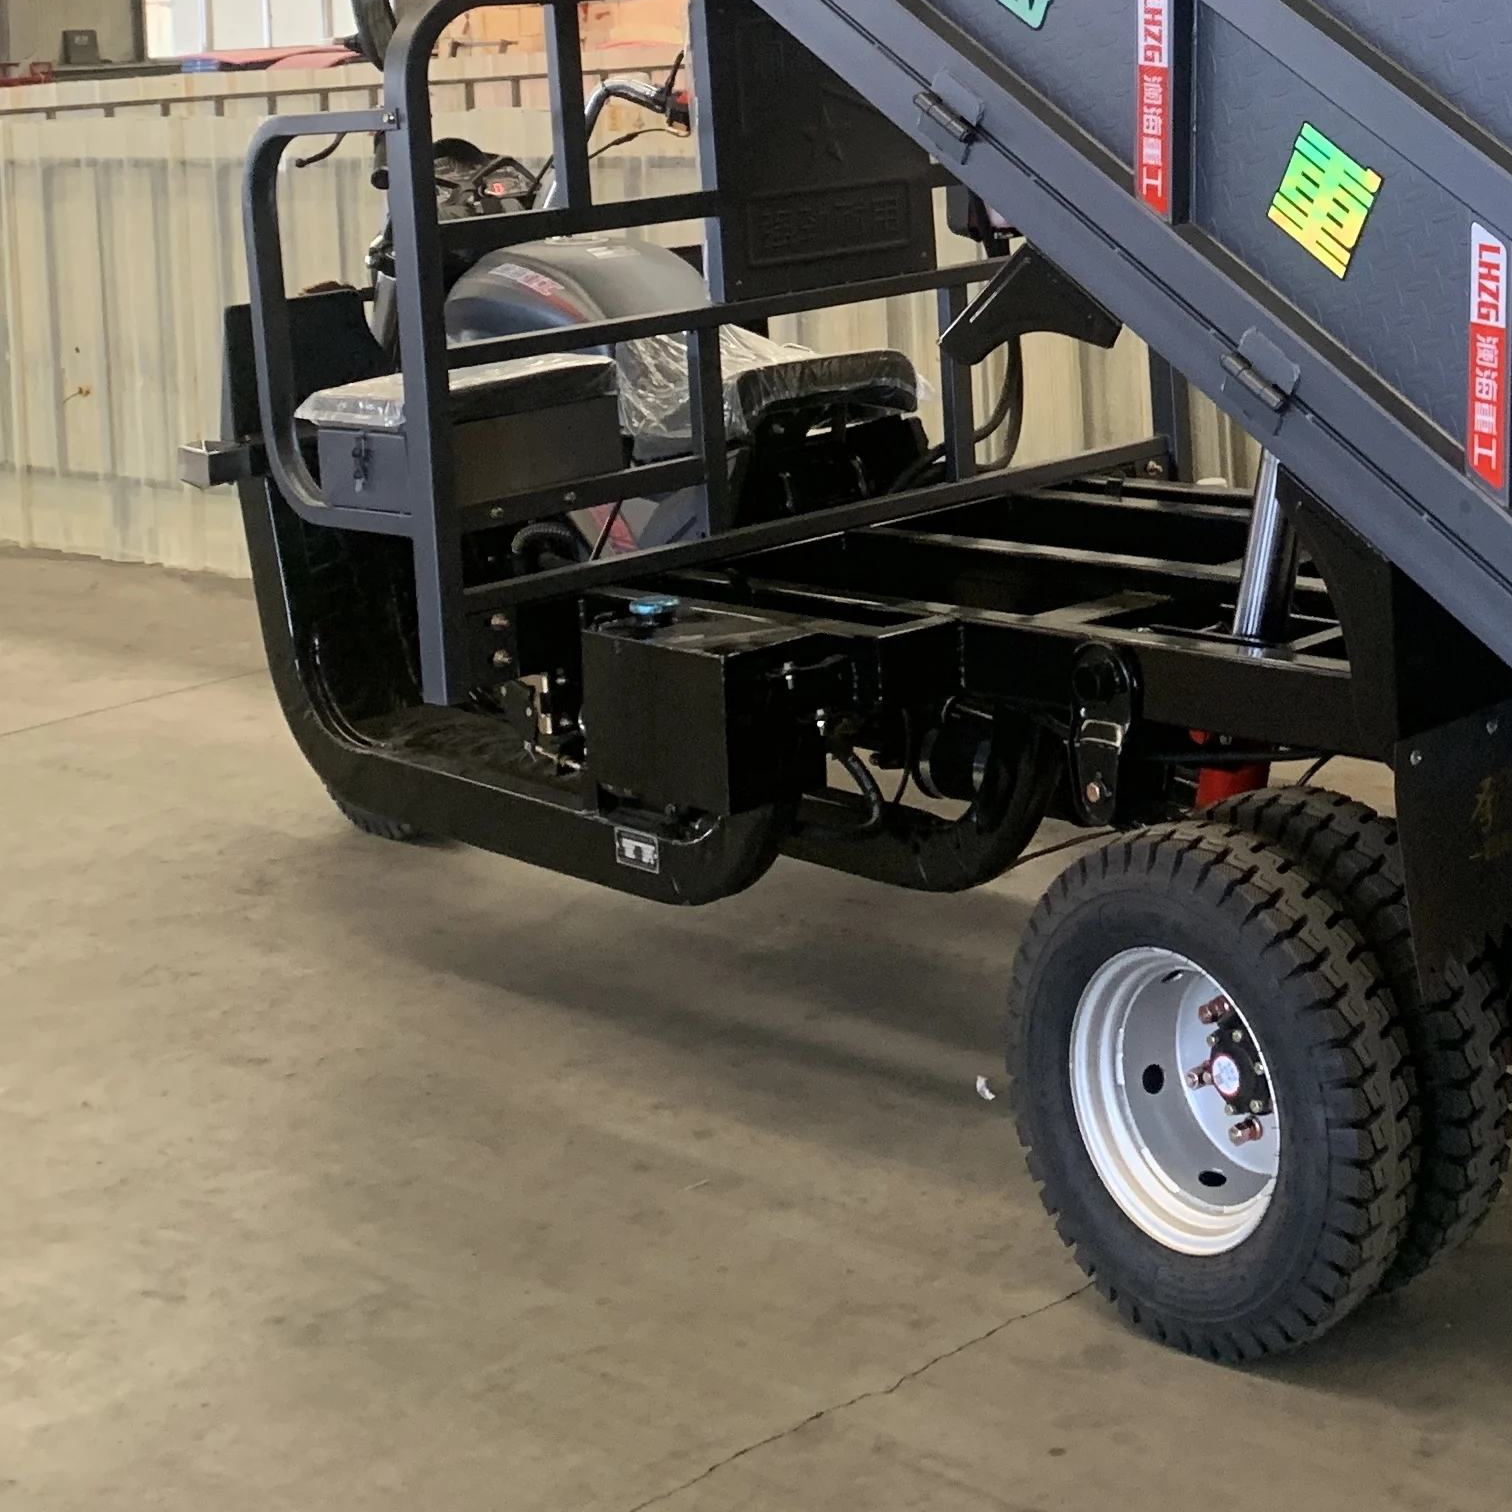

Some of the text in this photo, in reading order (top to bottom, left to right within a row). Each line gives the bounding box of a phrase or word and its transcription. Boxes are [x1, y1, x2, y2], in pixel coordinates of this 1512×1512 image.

[1142, 74, 1164, 198] 澜海重工
[1265, 120, 1385, 280] 重
[1473, 243, 1501, 470] LHZG 澜海重工
